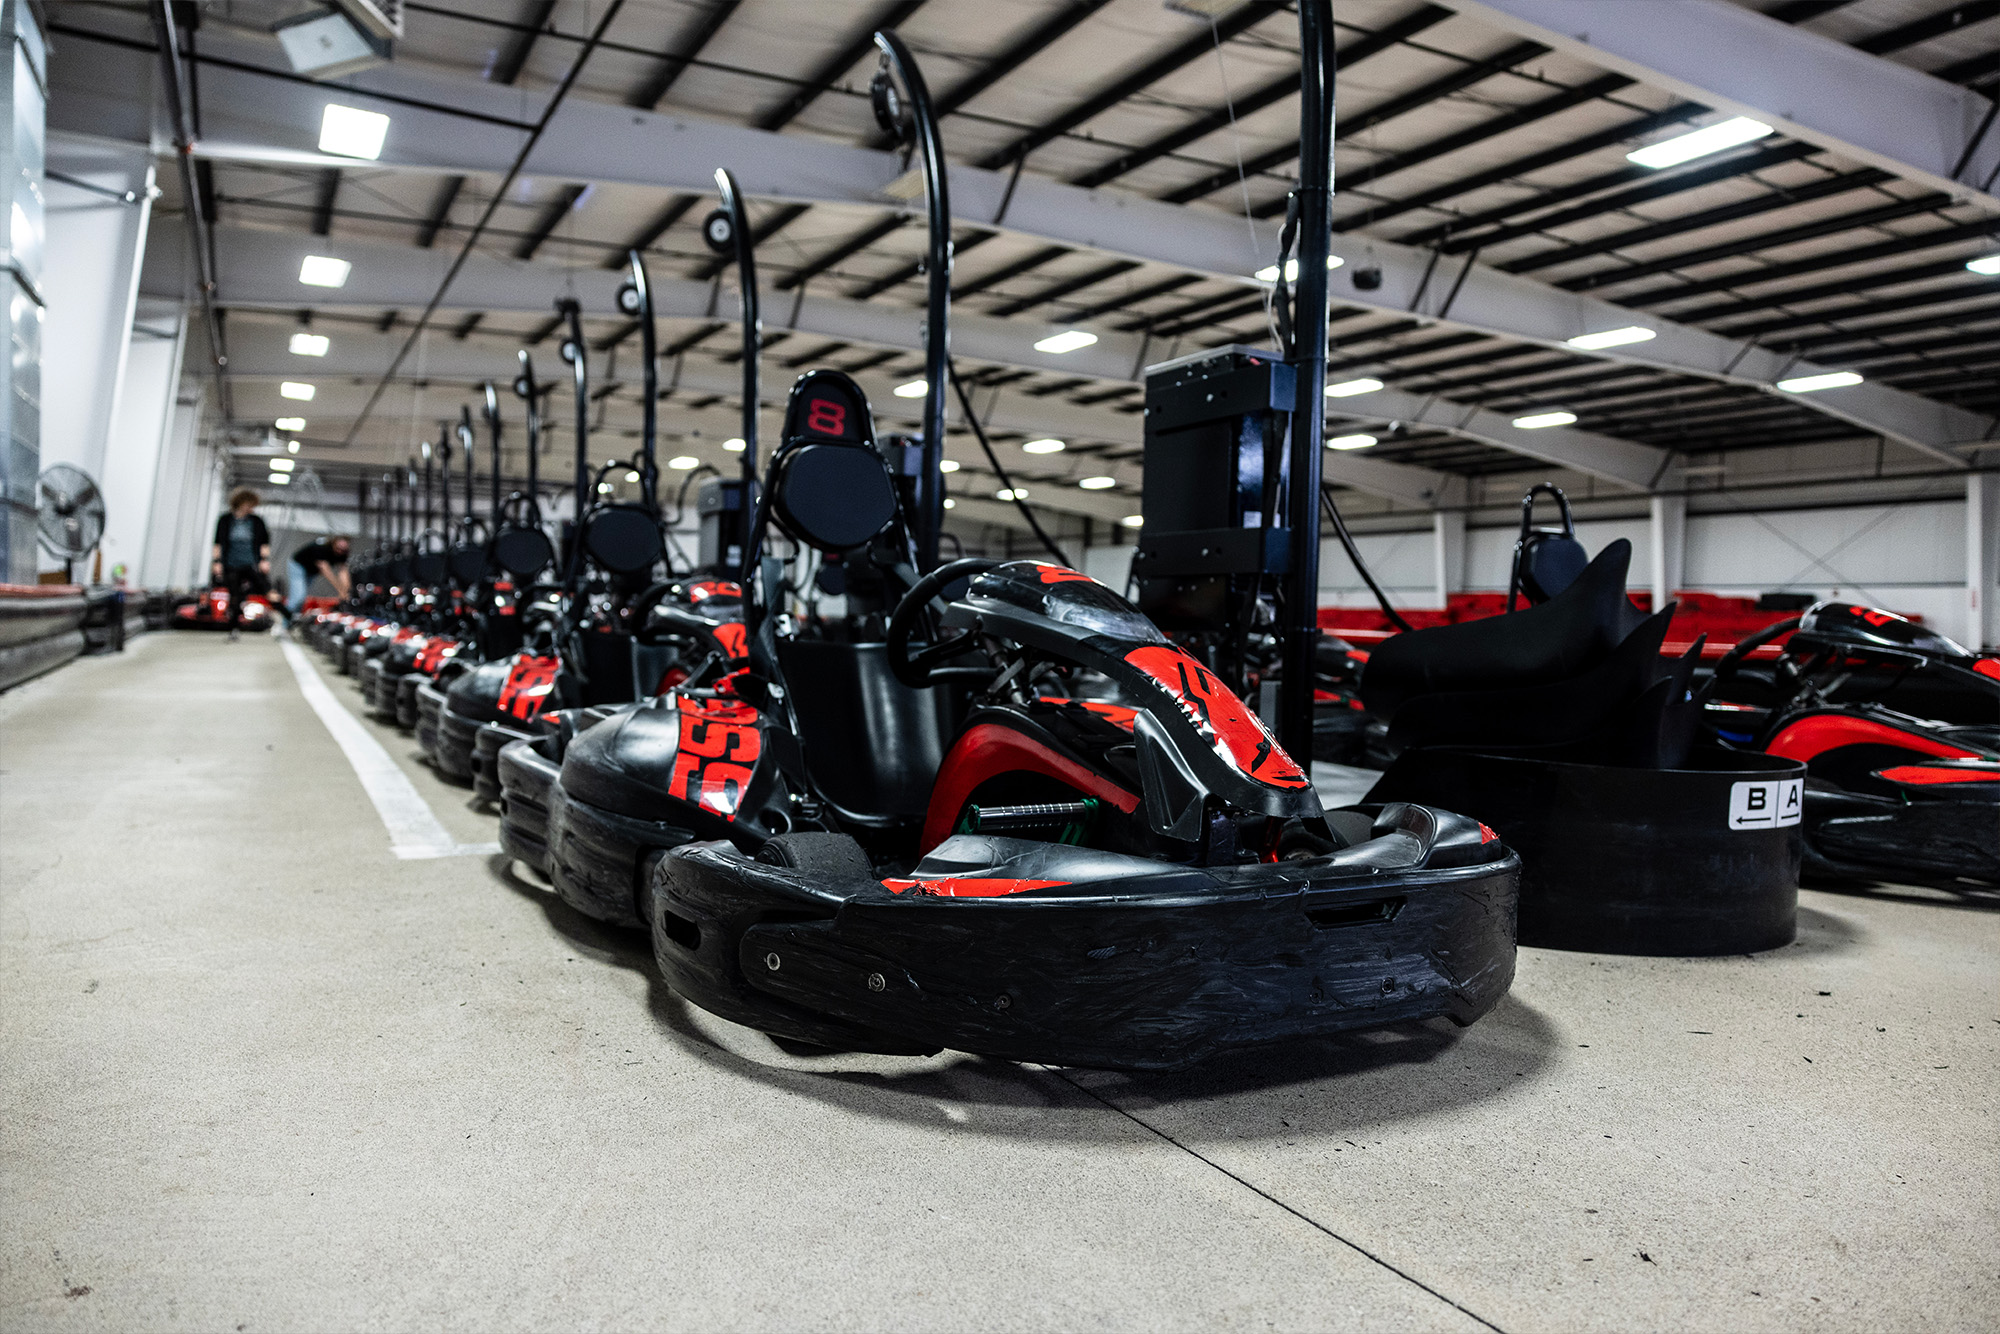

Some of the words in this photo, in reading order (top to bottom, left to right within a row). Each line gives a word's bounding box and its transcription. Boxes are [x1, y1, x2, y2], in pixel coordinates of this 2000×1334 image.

[808, 399, 845, 436] 8
[1748, 787, 1767, 811] B
[1787, 784, 1799, 808] A
